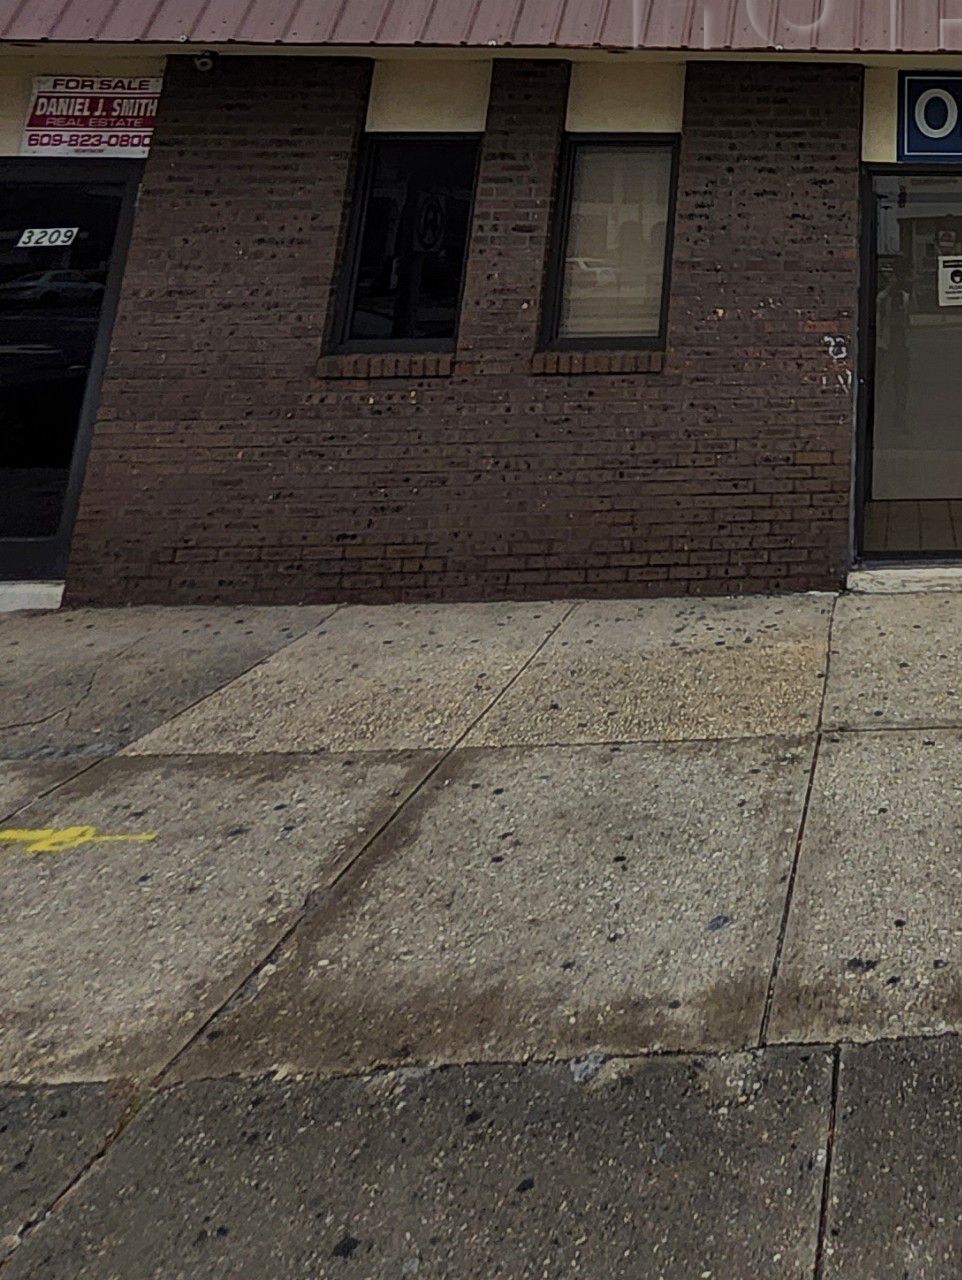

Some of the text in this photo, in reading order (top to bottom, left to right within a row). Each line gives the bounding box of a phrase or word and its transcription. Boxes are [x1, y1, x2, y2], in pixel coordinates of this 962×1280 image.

[53, 79, 150, 90] FOR SALE
[36, 98, 157, 116] DANIEL J. SMITH
[46, 117, 143, 127] REAL ESTATE
[21, 229, 75, 245] 3209
